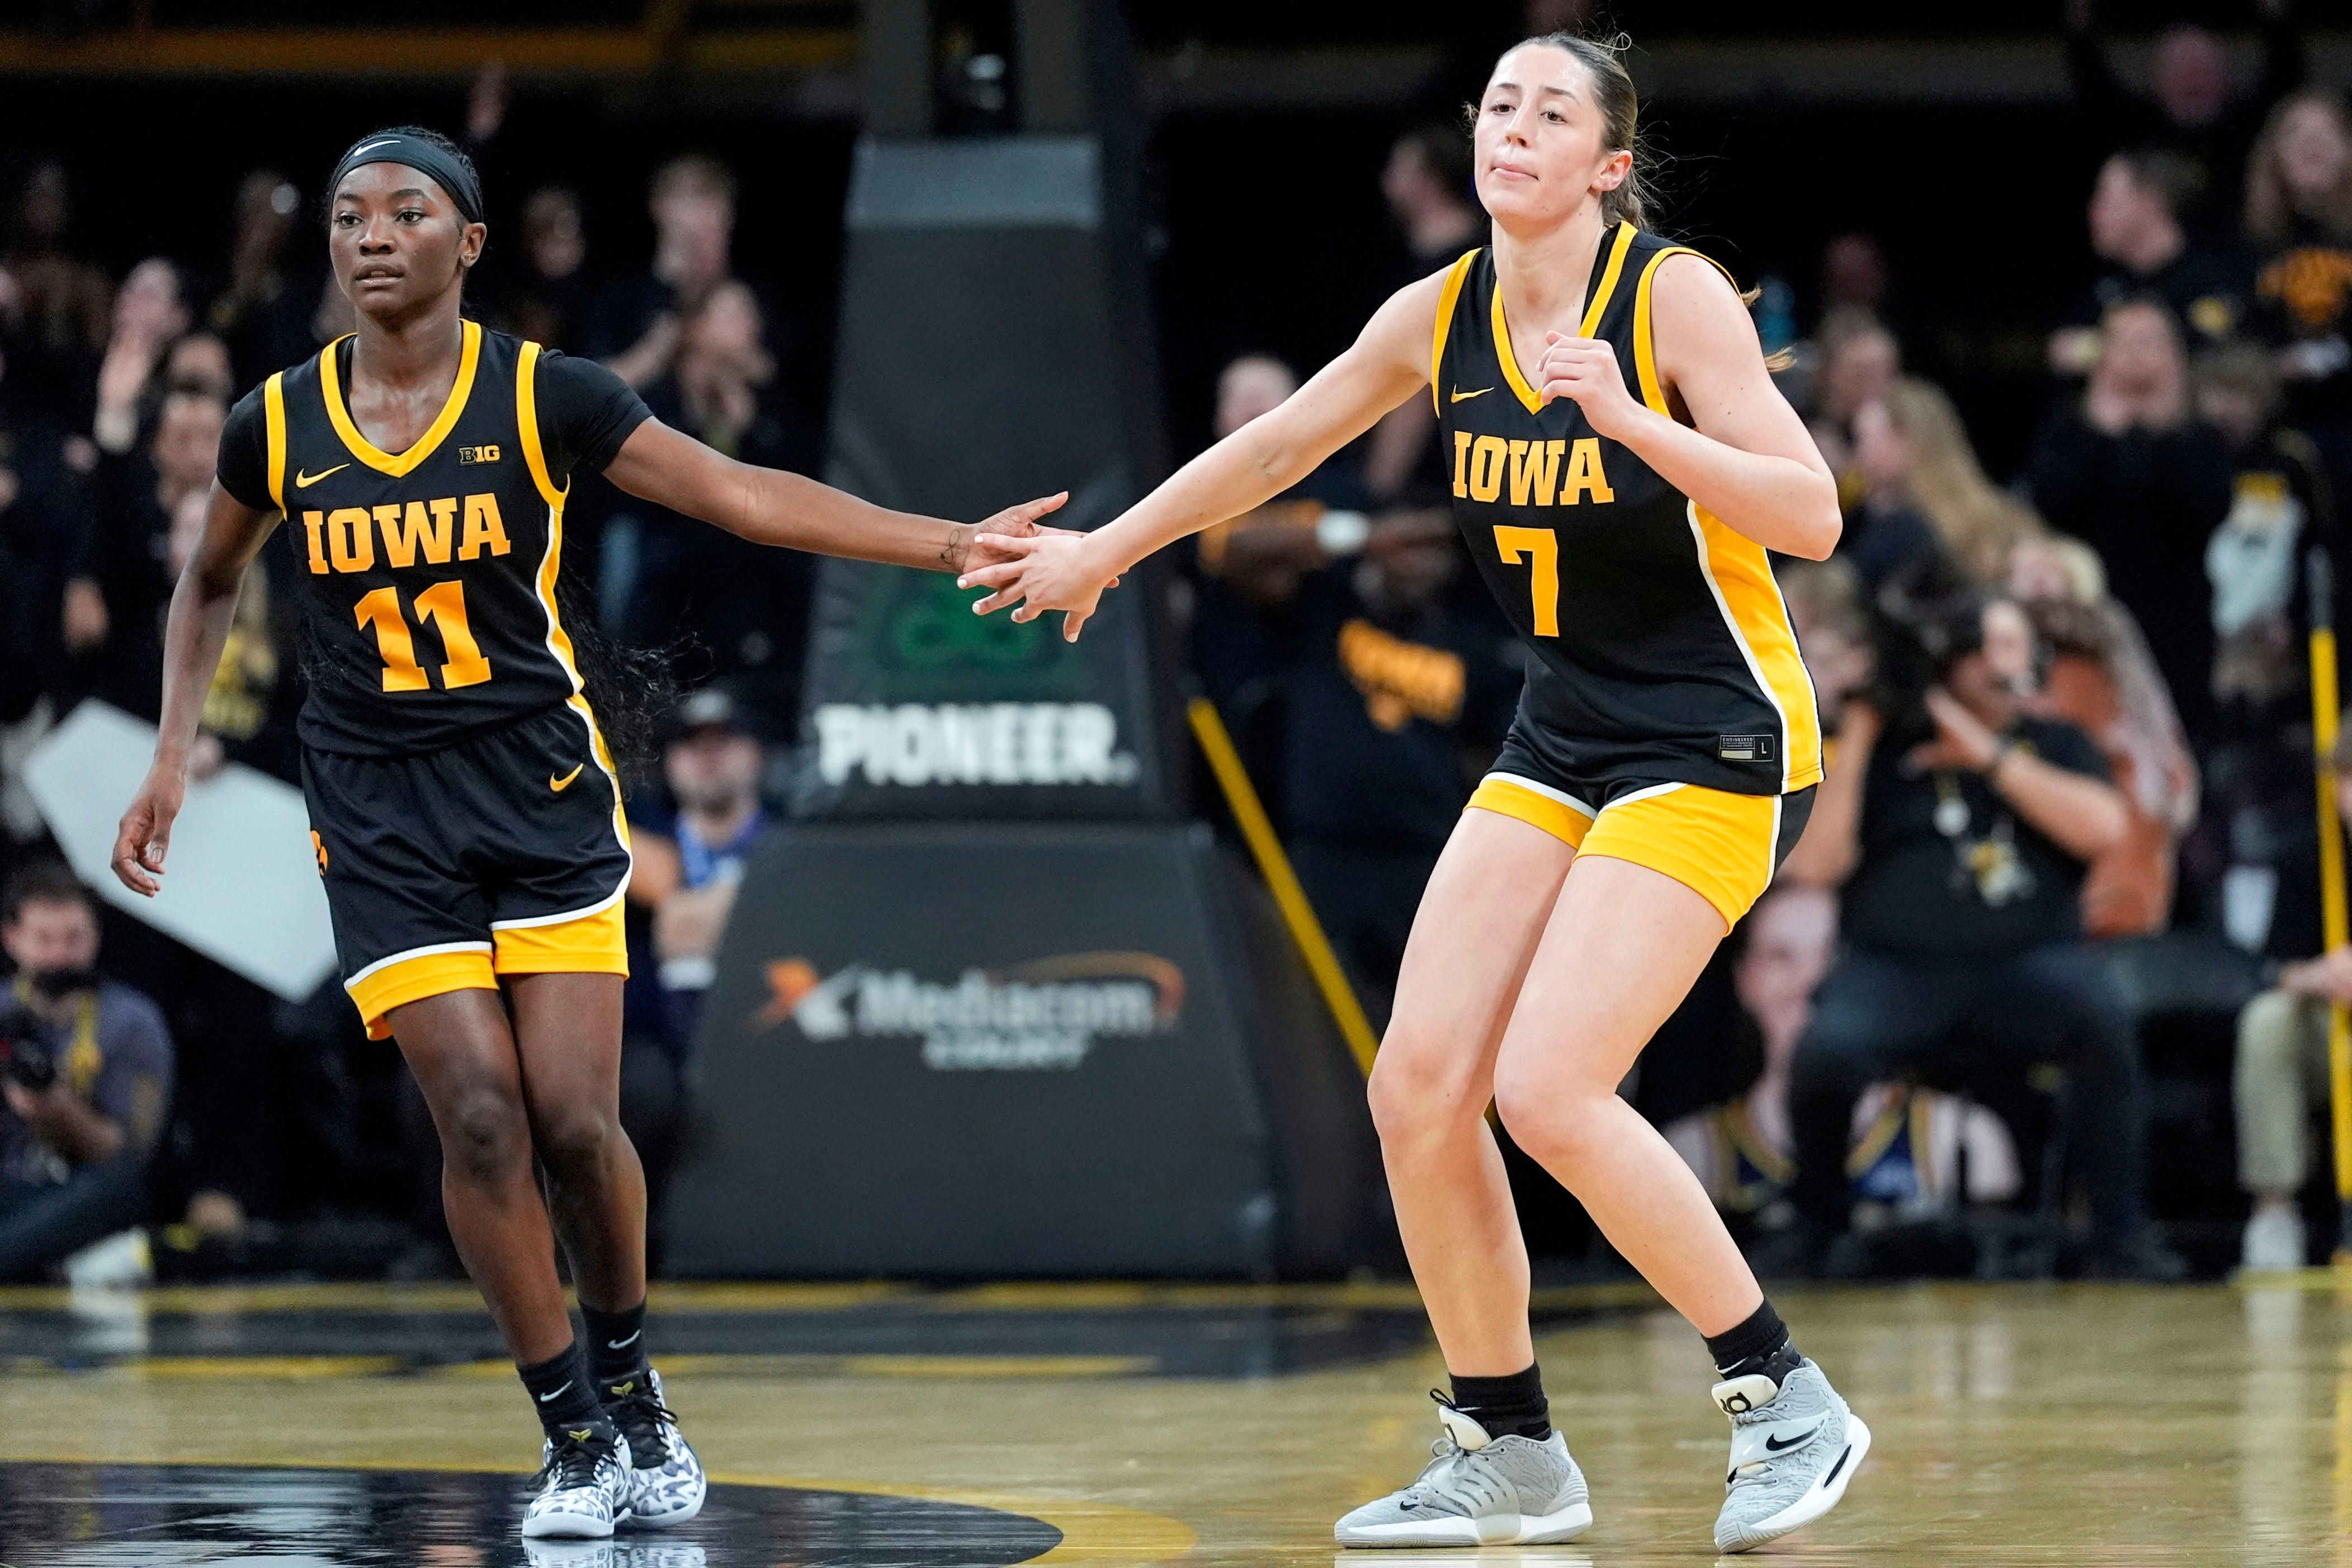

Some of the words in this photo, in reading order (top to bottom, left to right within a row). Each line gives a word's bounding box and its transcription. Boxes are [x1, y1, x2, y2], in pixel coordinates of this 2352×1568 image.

[1453, 431, 1615, 506] IOWA
[303, 493, 511, 574] IOWA
[1493, 525, 1560, 637] 7
[354, 580, 492, 693] 11
[1761, 742, 1767, 754] L
